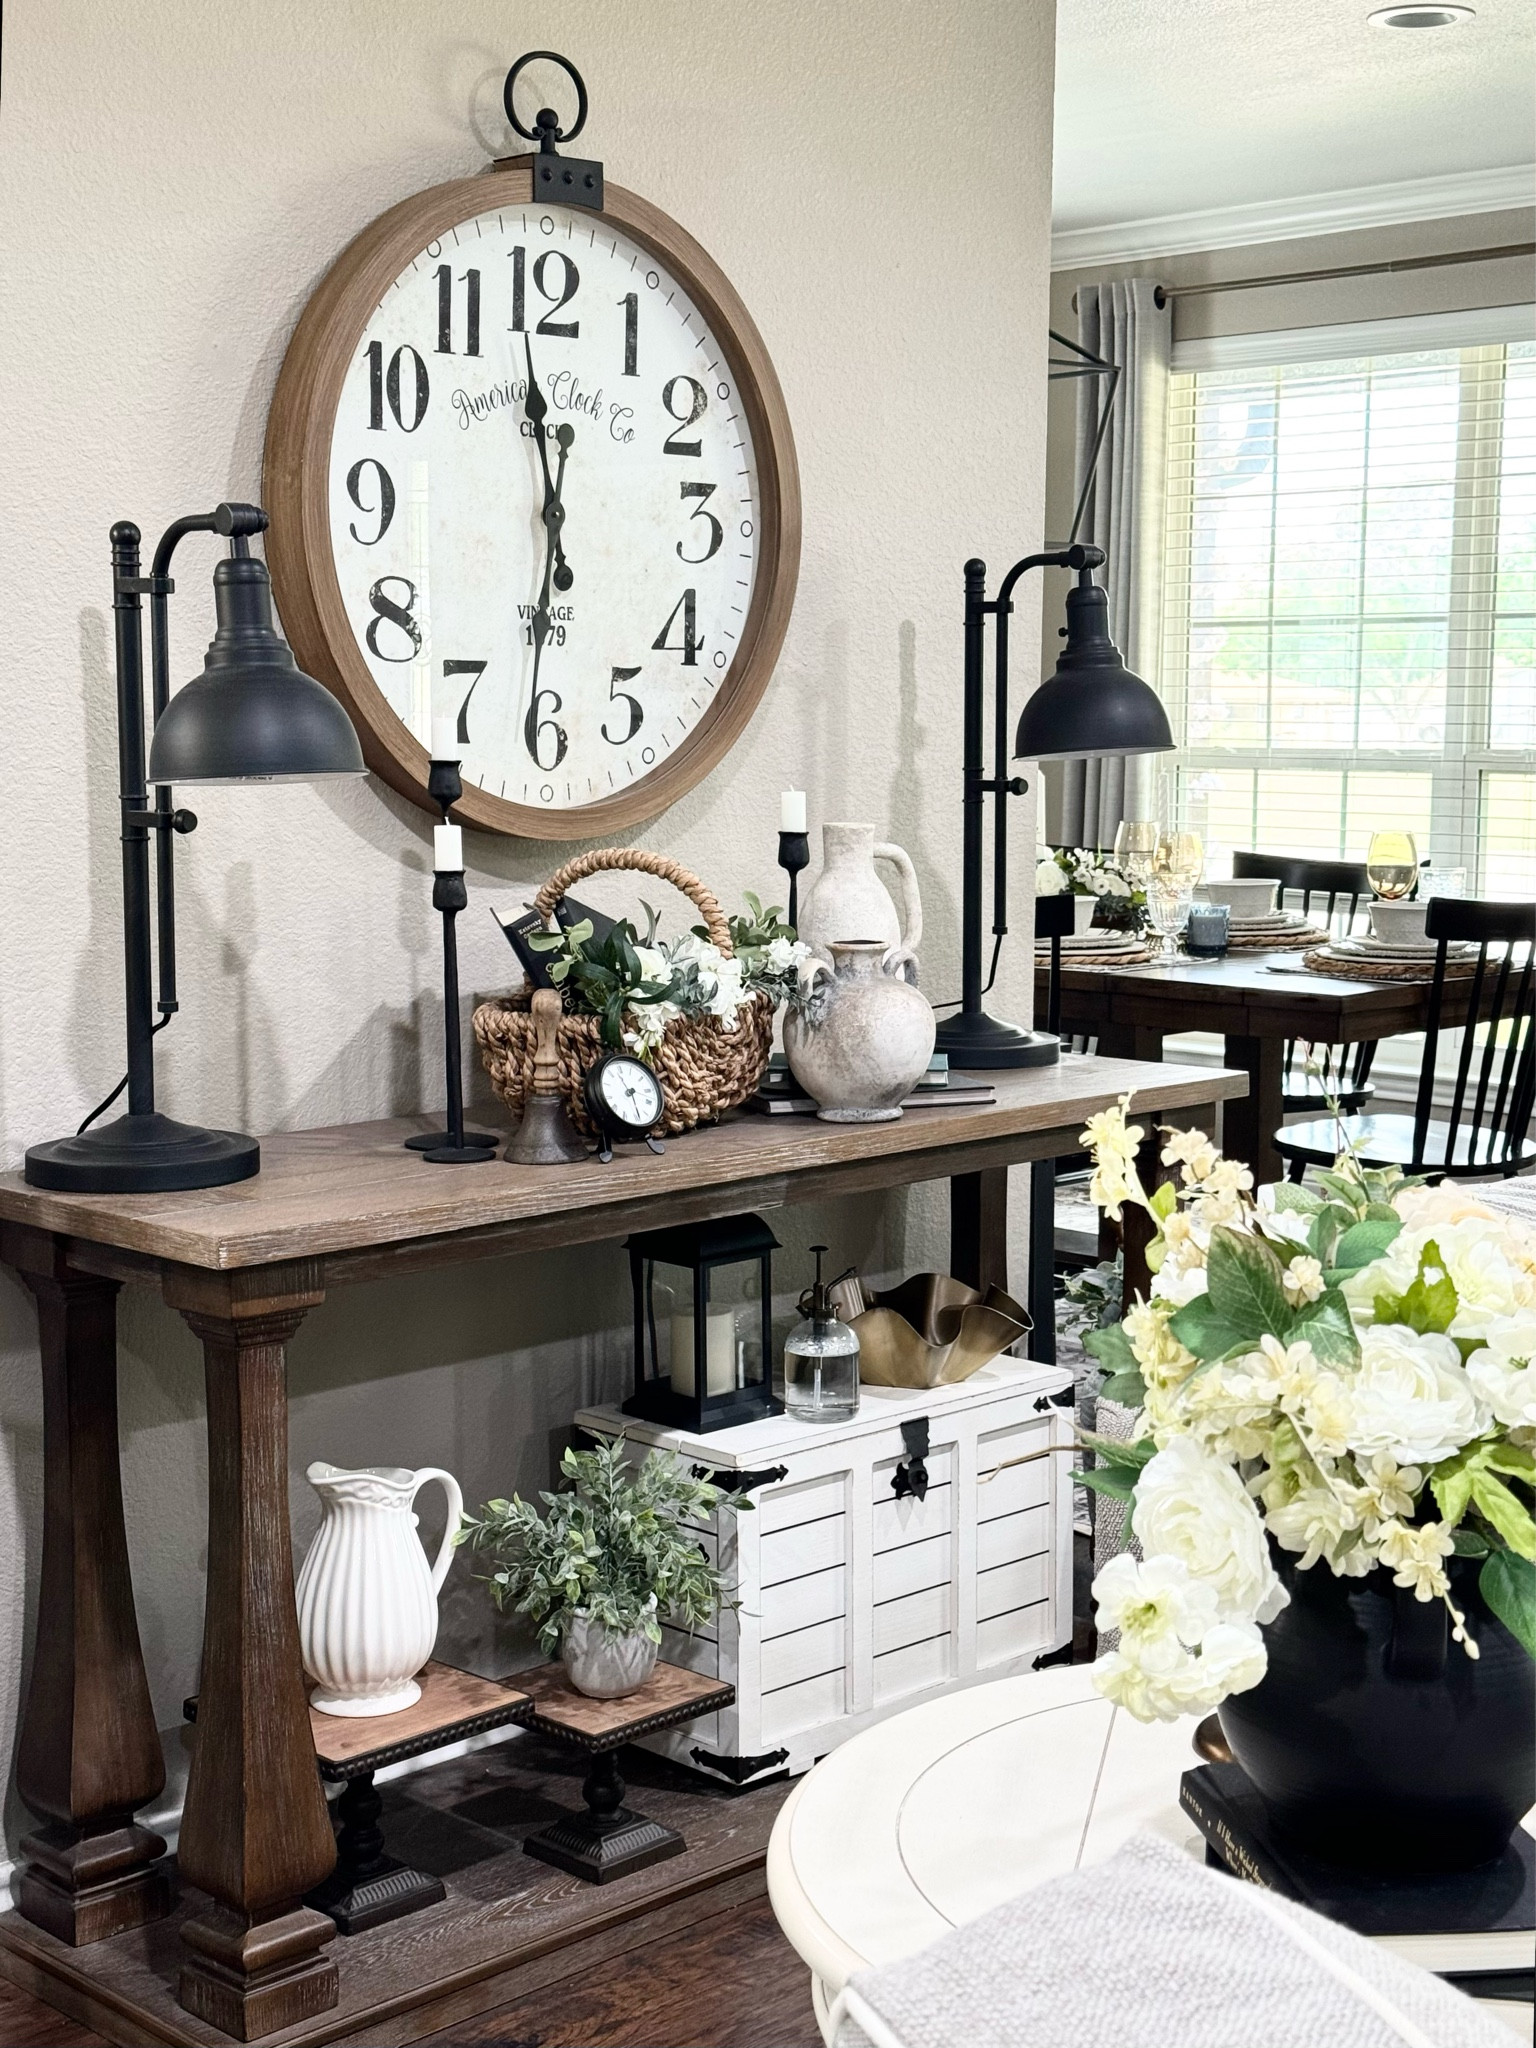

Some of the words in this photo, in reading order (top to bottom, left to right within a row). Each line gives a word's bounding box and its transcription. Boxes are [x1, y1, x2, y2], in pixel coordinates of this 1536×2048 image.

[432, 264, 484, 358] 11
[507, 245, 580, 339] 12
[616, 292, 640, 377] 1
[363, 340, 430, 432] 10
[451, 379, 541, 430] America
[547, 371, 603, 420] Clock
[610, 403, 635, 443] Co
[662, 375, 708, 457] 2
[346, 458, 396, 545] 9
[676, 482, 723, 563] 3
[365, 576, 423, 663] 8
[517, 605, 575, 621] VINAGE
[525, 624, 566, 647] 179
[651, 588, 705, 666] 4
[443, 659, 488, 744] 7
[524, 689, 569, 772] 6
[600, 666, 644, 745] 5
